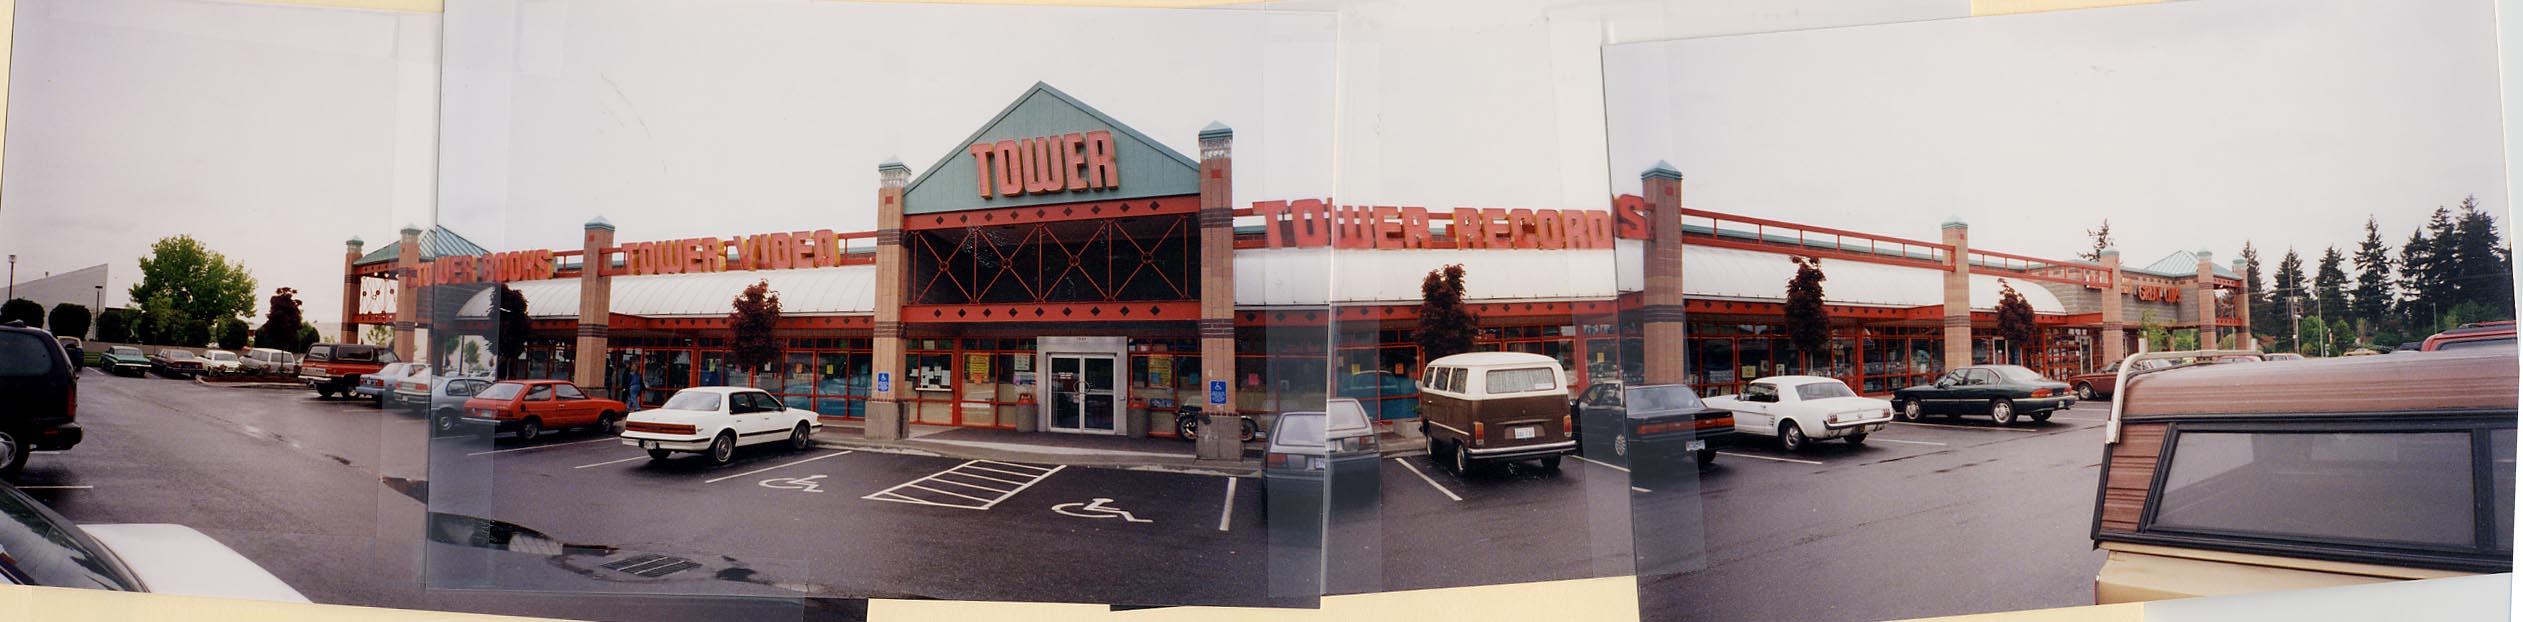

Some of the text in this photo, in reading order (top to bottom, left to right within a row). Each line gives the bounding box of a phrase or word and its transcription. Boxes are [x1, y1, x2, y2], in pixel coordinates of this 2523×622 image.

[970, 130, 1120, 200] TOWER
[1252, 193, 1654, 251] TOWER RECORDS
[482, 248, 553, 283] BOOKS
[621, 229, 840, 275] TOWER VIDEO
